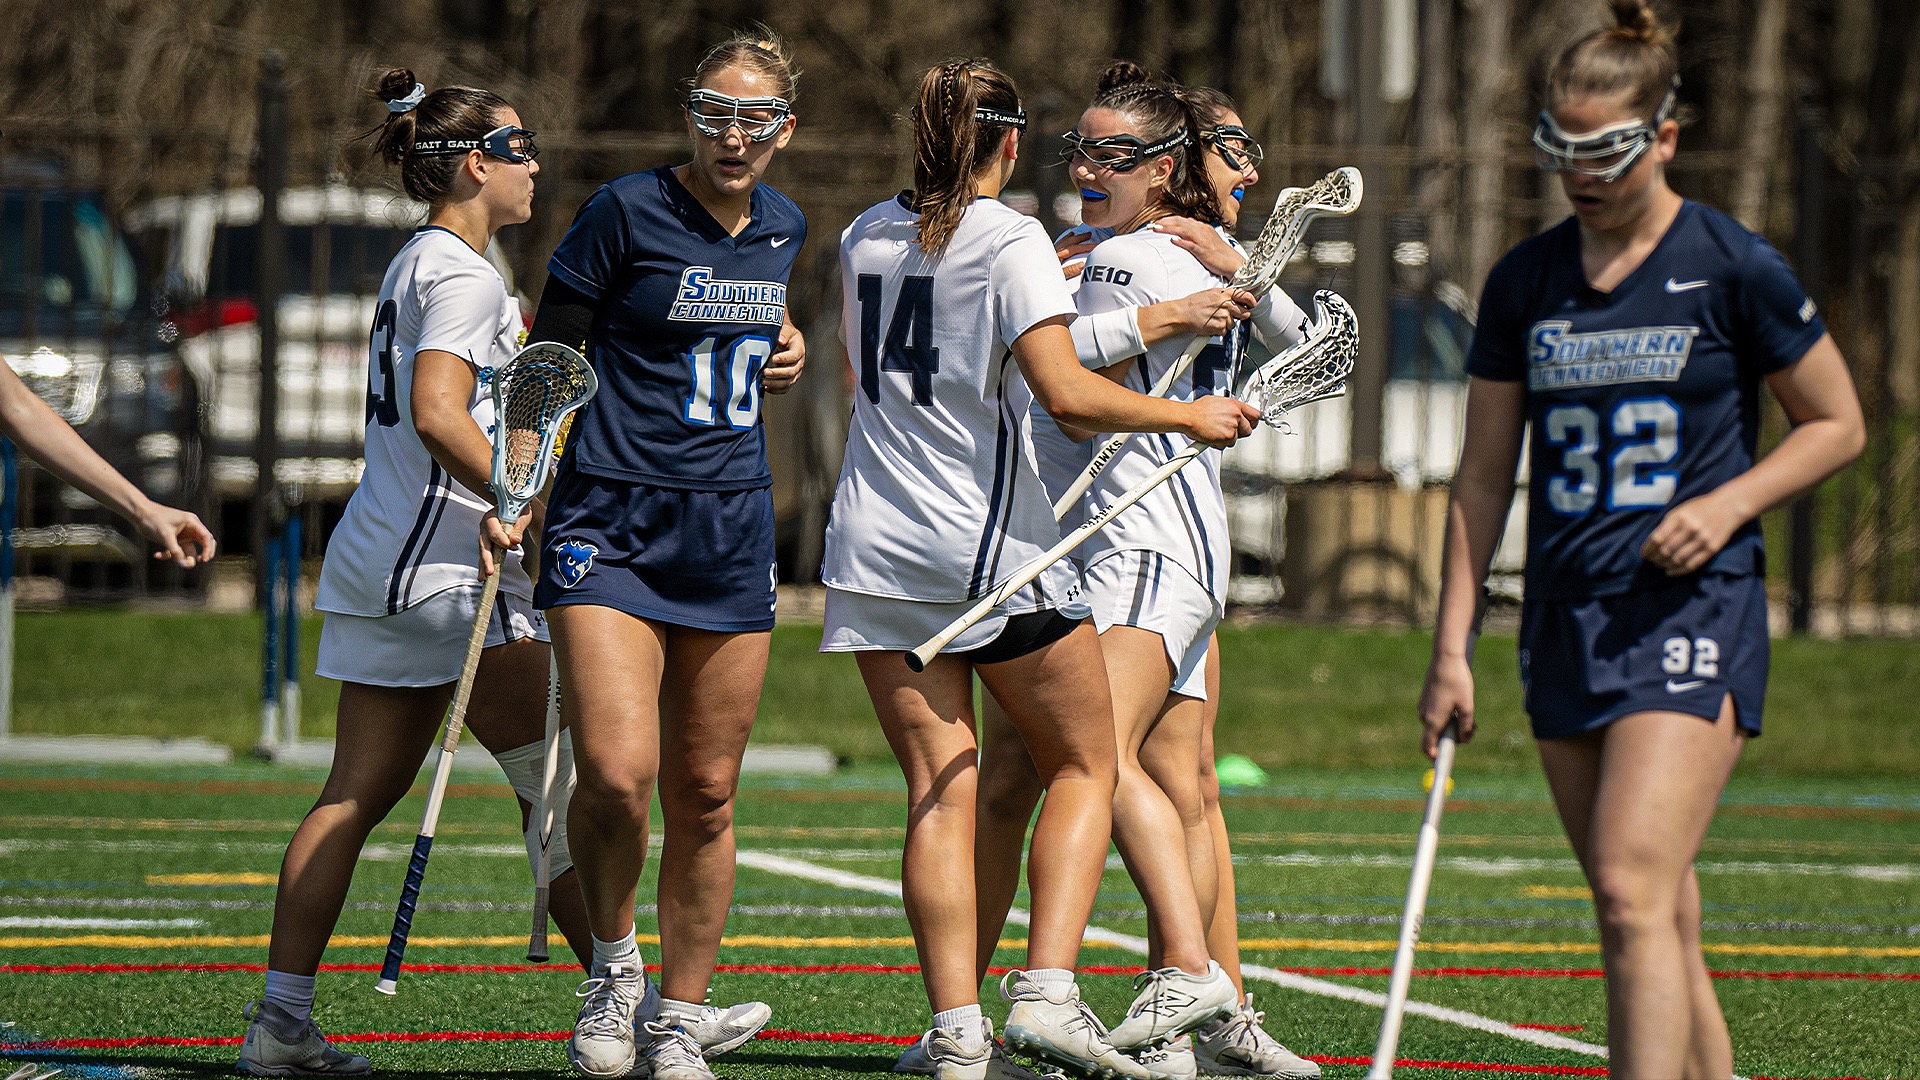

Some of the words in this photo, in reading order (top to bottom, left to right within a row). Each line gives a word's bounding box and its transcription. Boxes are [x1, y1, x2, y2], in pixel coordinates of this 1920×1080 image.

[1000, 115, 1018, 124] UNDER
[415, 141, 442, 150] GAIT
[447, 140, 479, 149] GAIT
[1081, 265, 1133, 287] NE10
[858, 272, 939, 406] 14
[366, 299, 400, 427] 3
[684, 334, 772, 430] 10
[1088, 440, 1123, 479] HAWKS
[1545, 396, 1682, 515] 32
[1662, 636, 1720, 678] 32
[1130, 1053, 1168, 1065] ance
